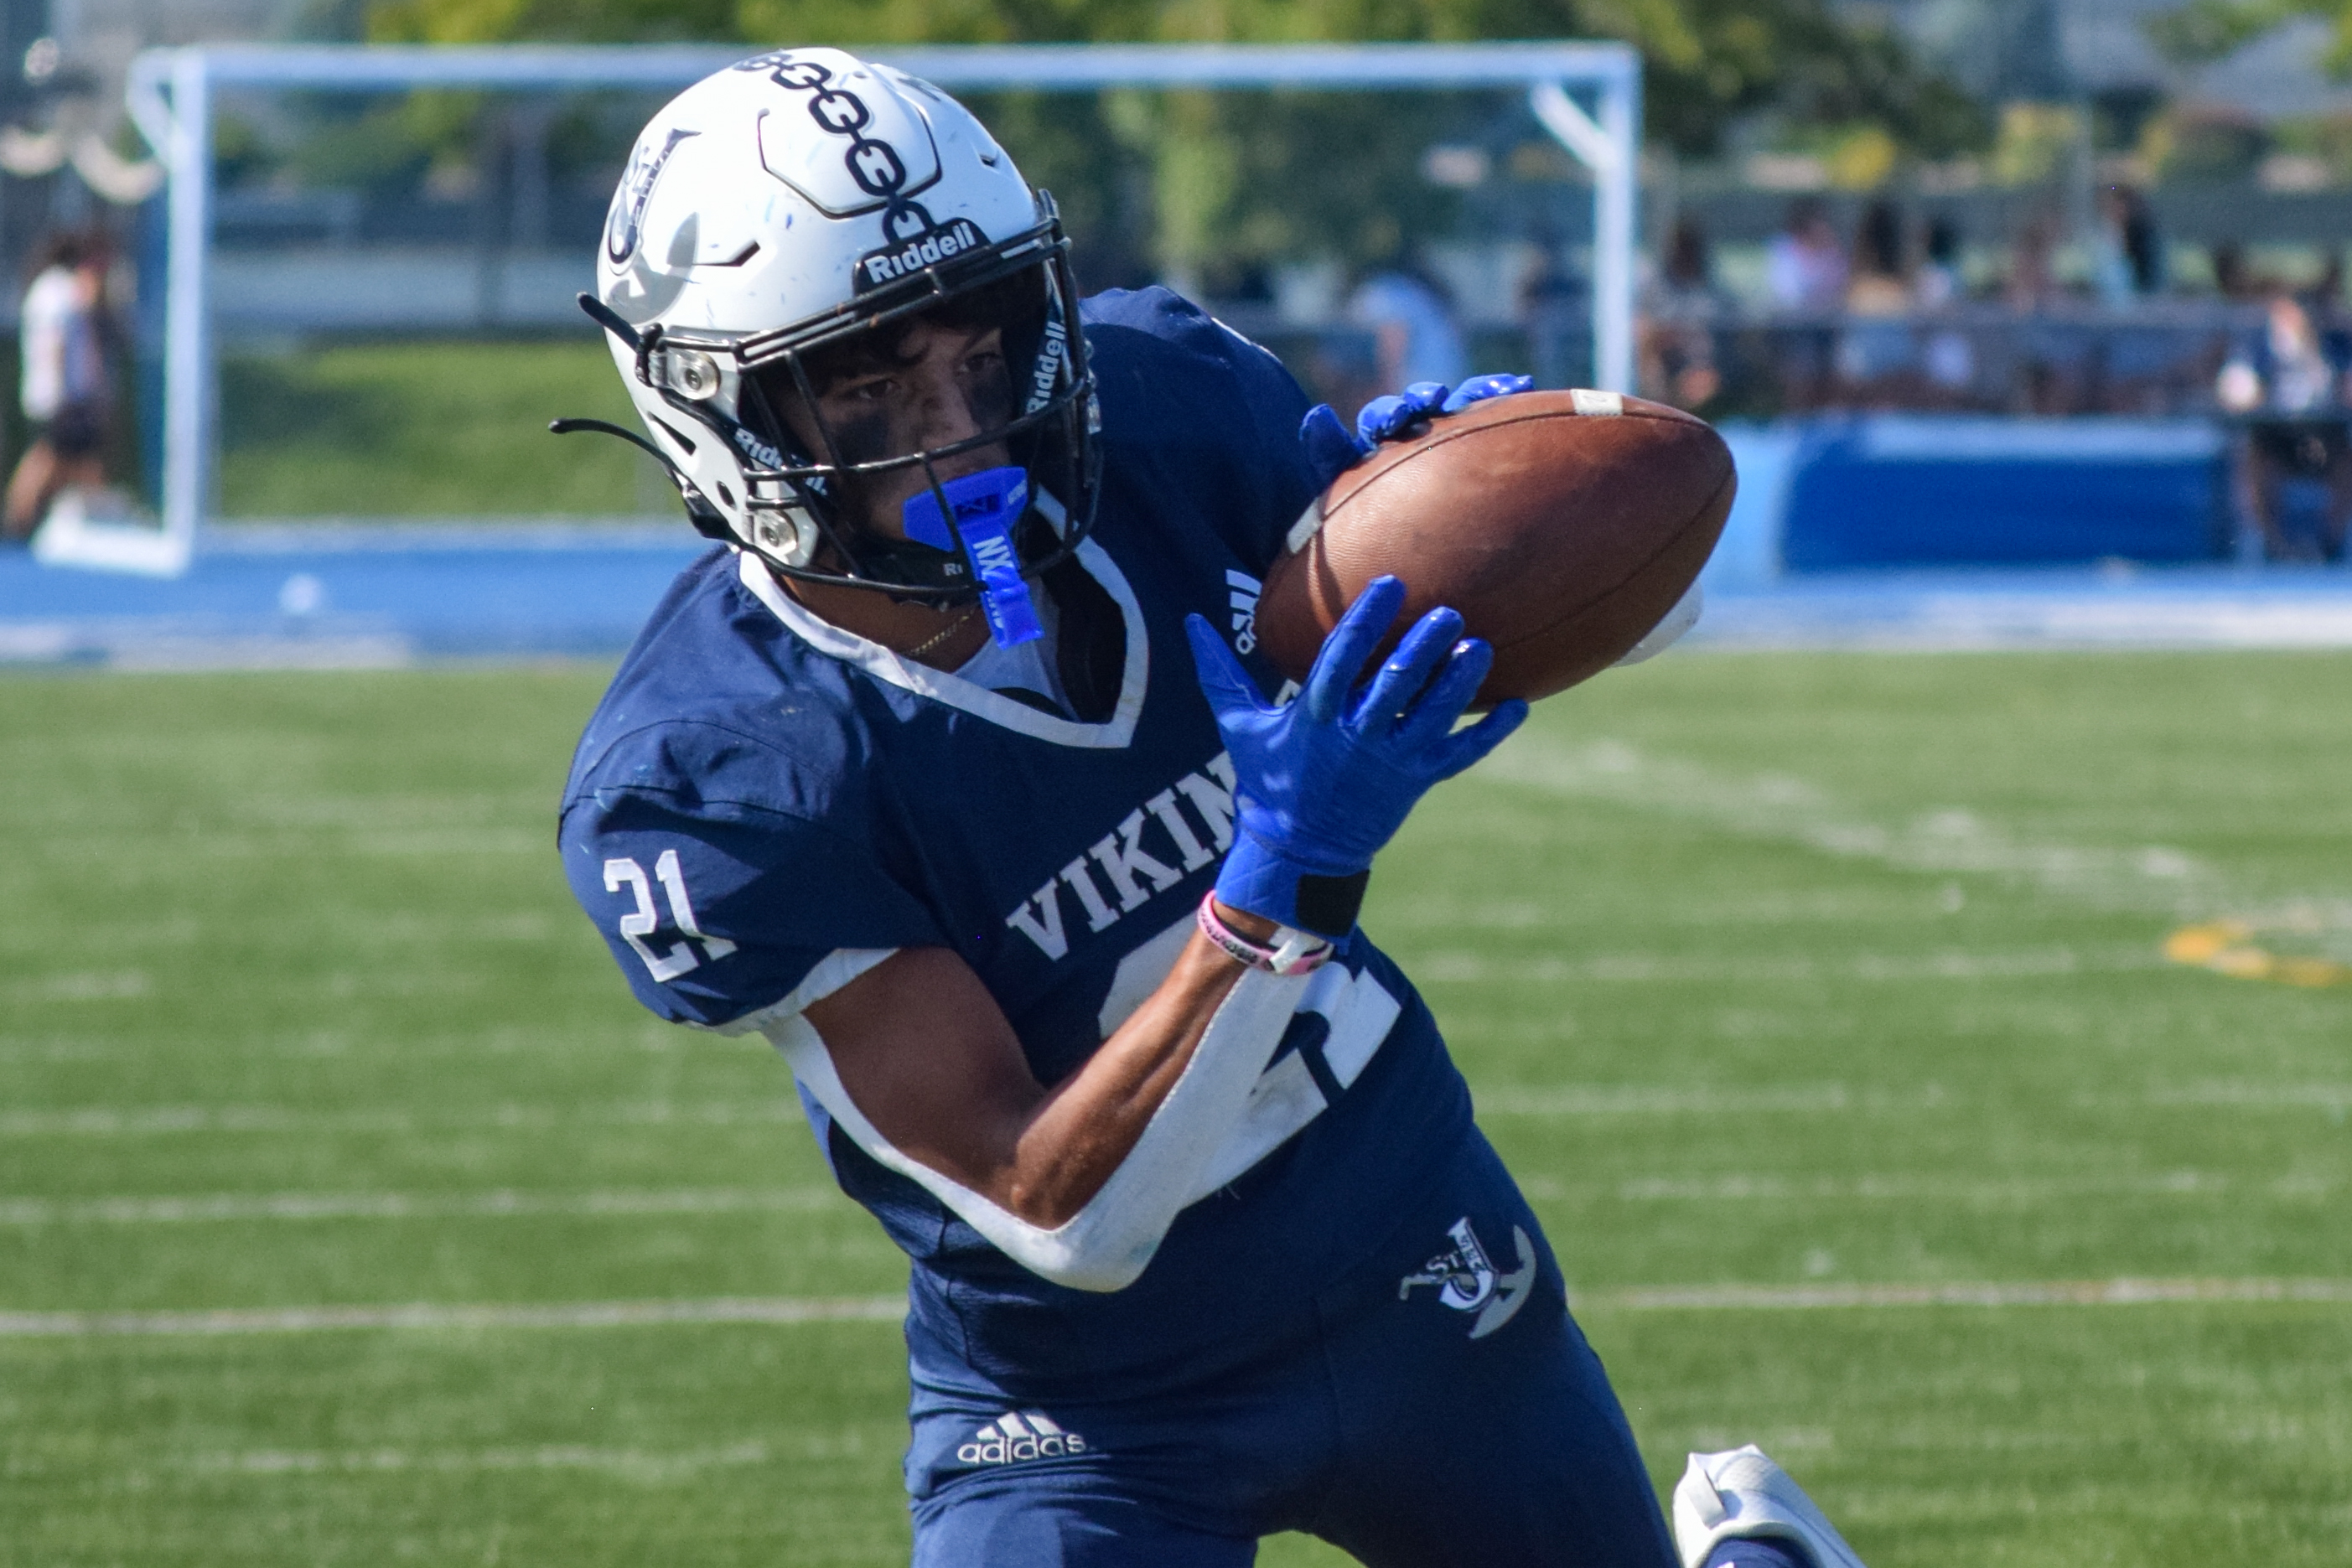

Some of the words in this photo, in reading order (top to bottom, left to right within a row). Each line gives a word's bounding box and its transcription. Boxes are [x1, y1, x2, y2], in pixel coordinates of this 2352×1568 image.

[864, 221, 977, 284] Riddell
[603, 849, 738, 983] 21
[956, 1432, 1087, 1465] adidas
